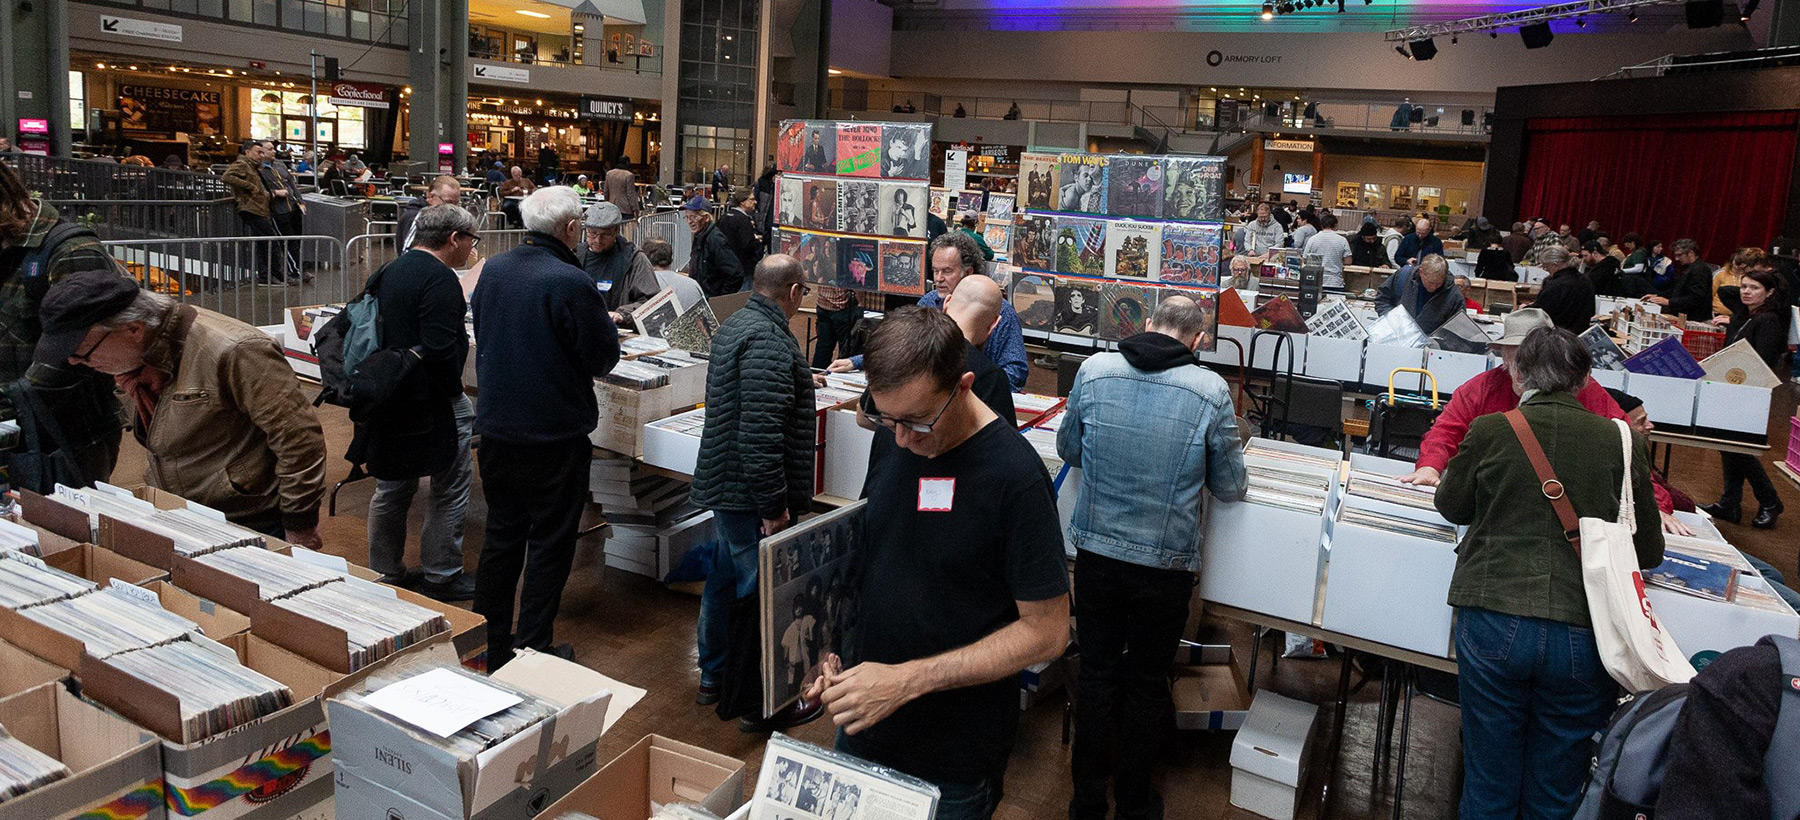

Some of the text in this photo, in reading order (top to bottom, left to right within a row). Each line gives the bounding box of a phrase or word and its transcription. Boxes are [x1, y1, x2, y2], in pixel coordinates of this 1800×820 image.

[1225, 55, 1282, 63] ARMORY LOFT
[122, 85, 218, 103] CHEESECAKE
[337, 86, 383, 100] Confectional
[497, 105, 532, 115] BURGERS
[590, 100, 623, 115] QUINCY'S
[837, 134, 881, 143] THE BOLLOCKS
[1265, 141, 1313, 150] INFORMATION
[1062, 155, 1110, 167] TOM WAITS
[1202, 165, 1219, 173] DEEP
[375, 747, 412, 775] SILENI
